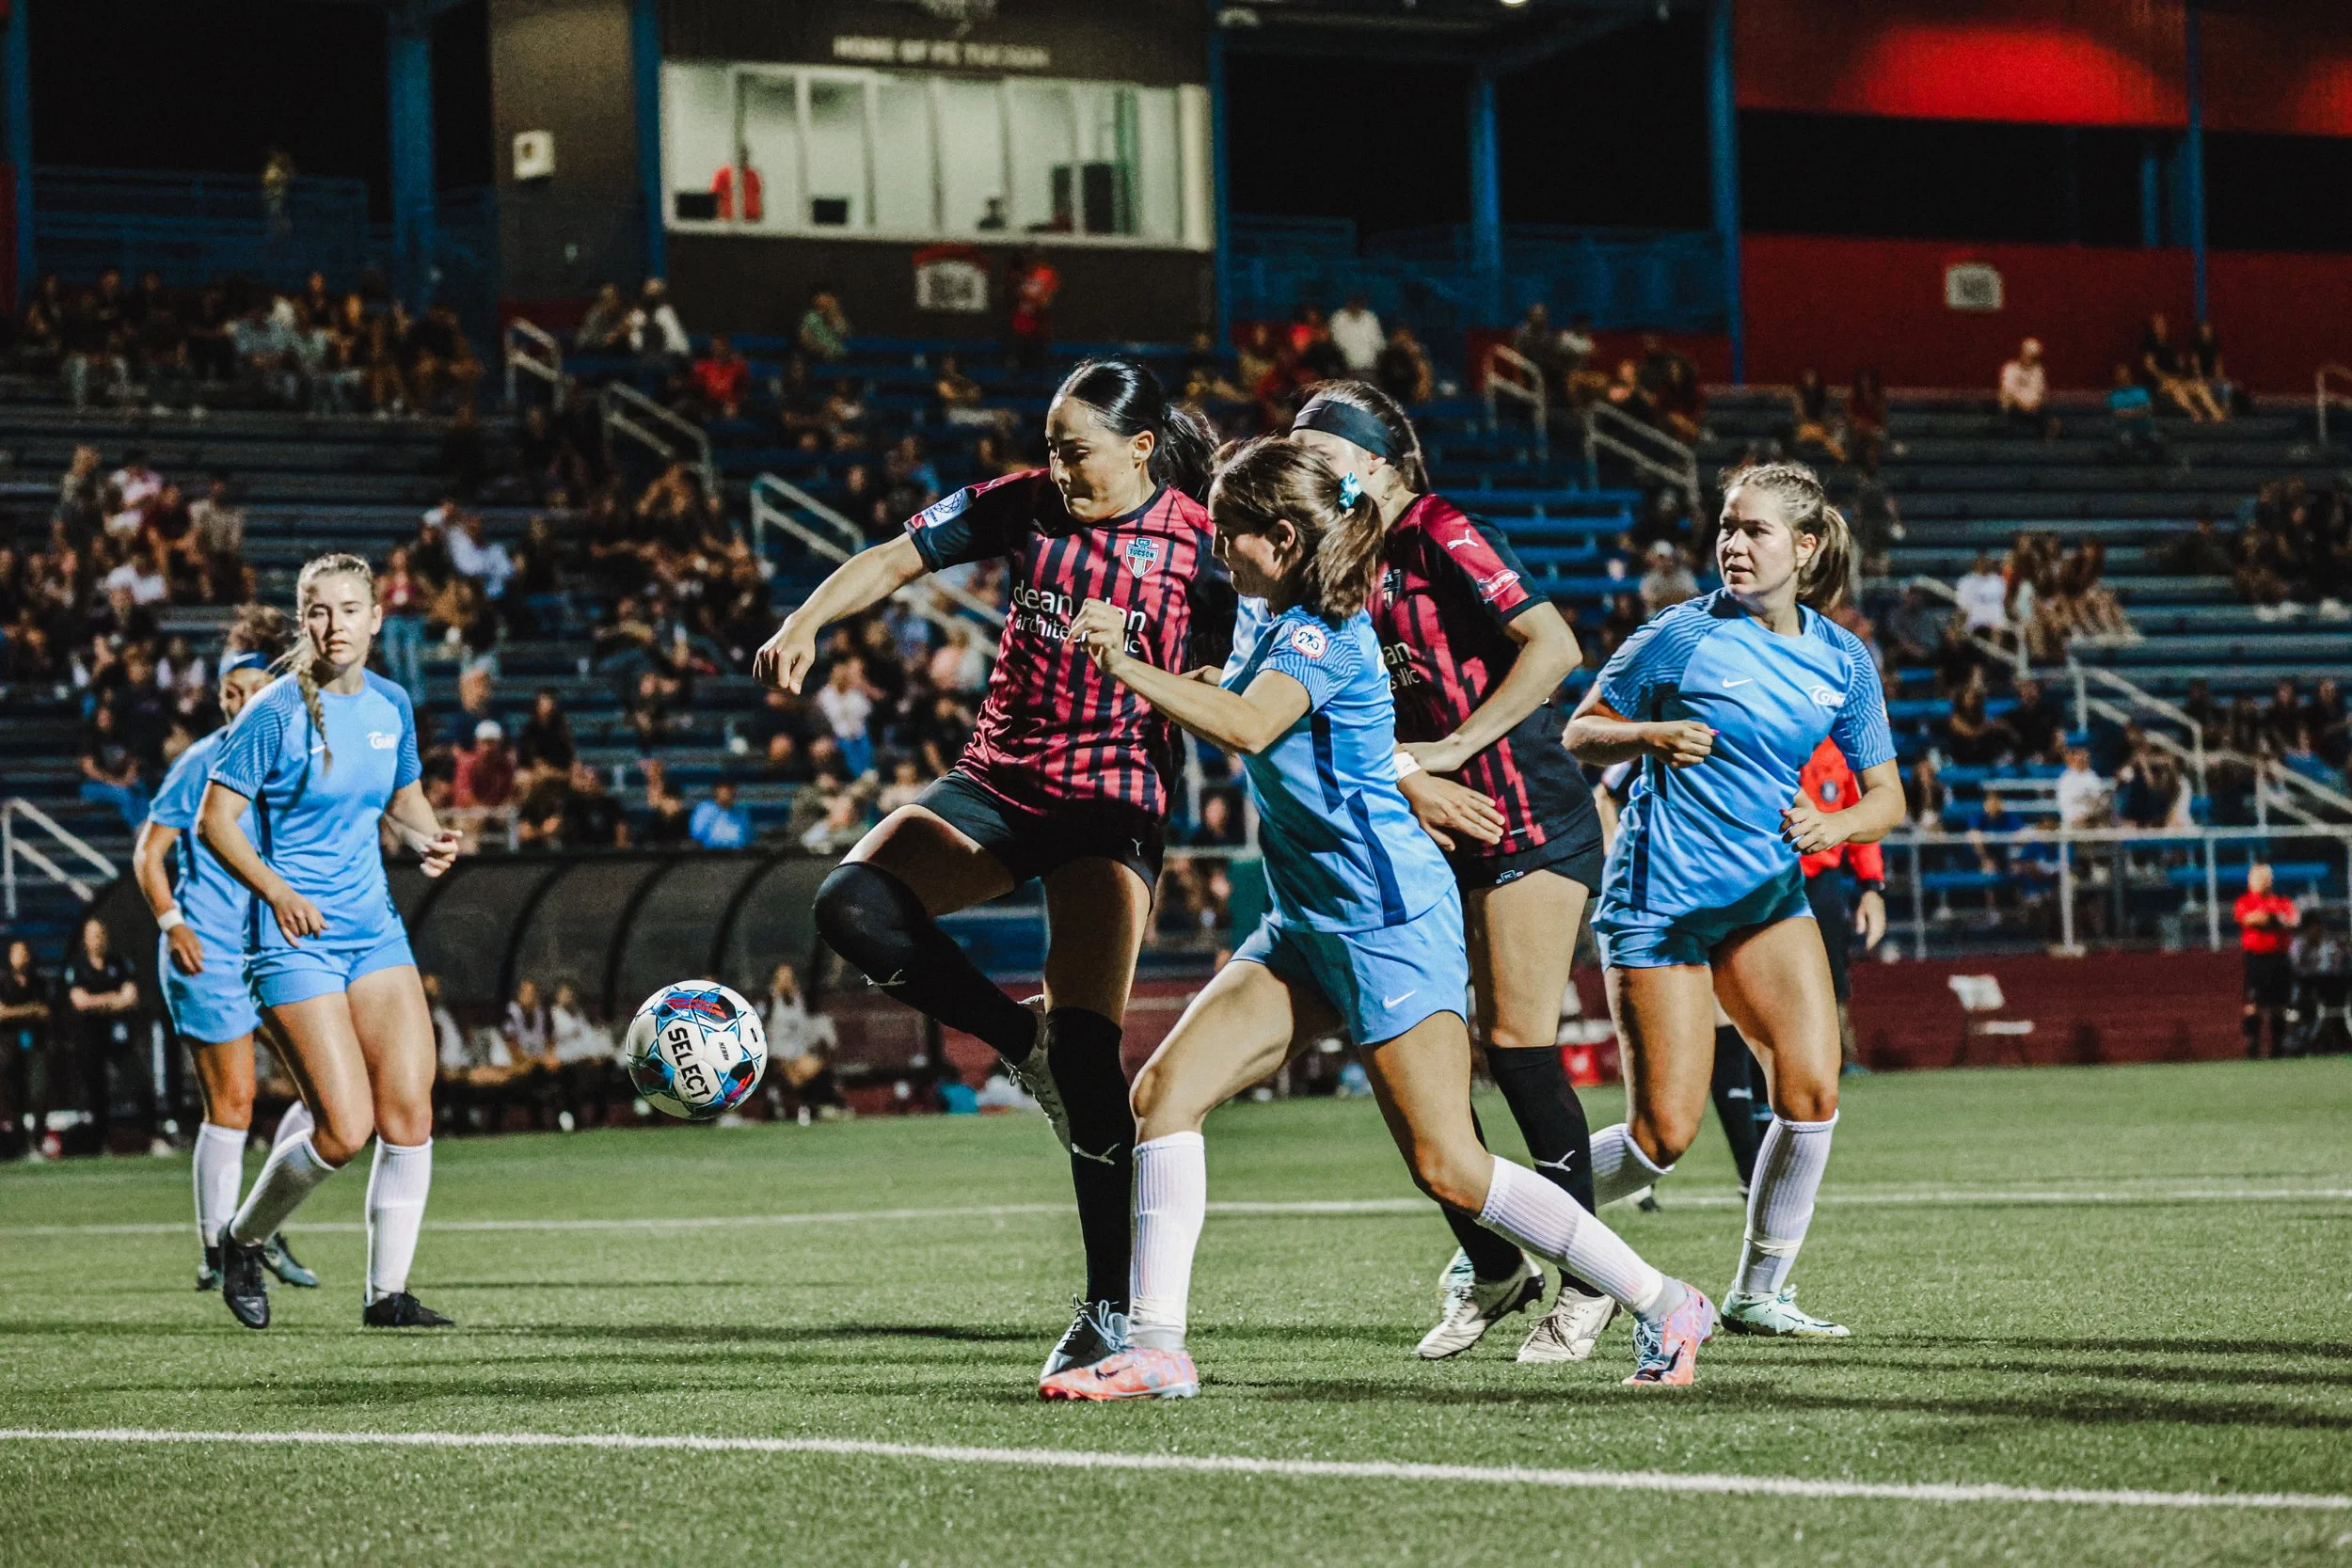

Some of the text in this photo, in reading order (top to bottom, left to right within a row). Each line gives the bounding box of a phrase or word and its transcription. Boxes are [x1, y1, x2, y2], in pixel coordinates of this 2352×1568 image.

[1129, 548, 1154, 558] TUCSON
[1014, 579, 1073, 616] dean
[667, 1027, 711, 1099] SELECT
